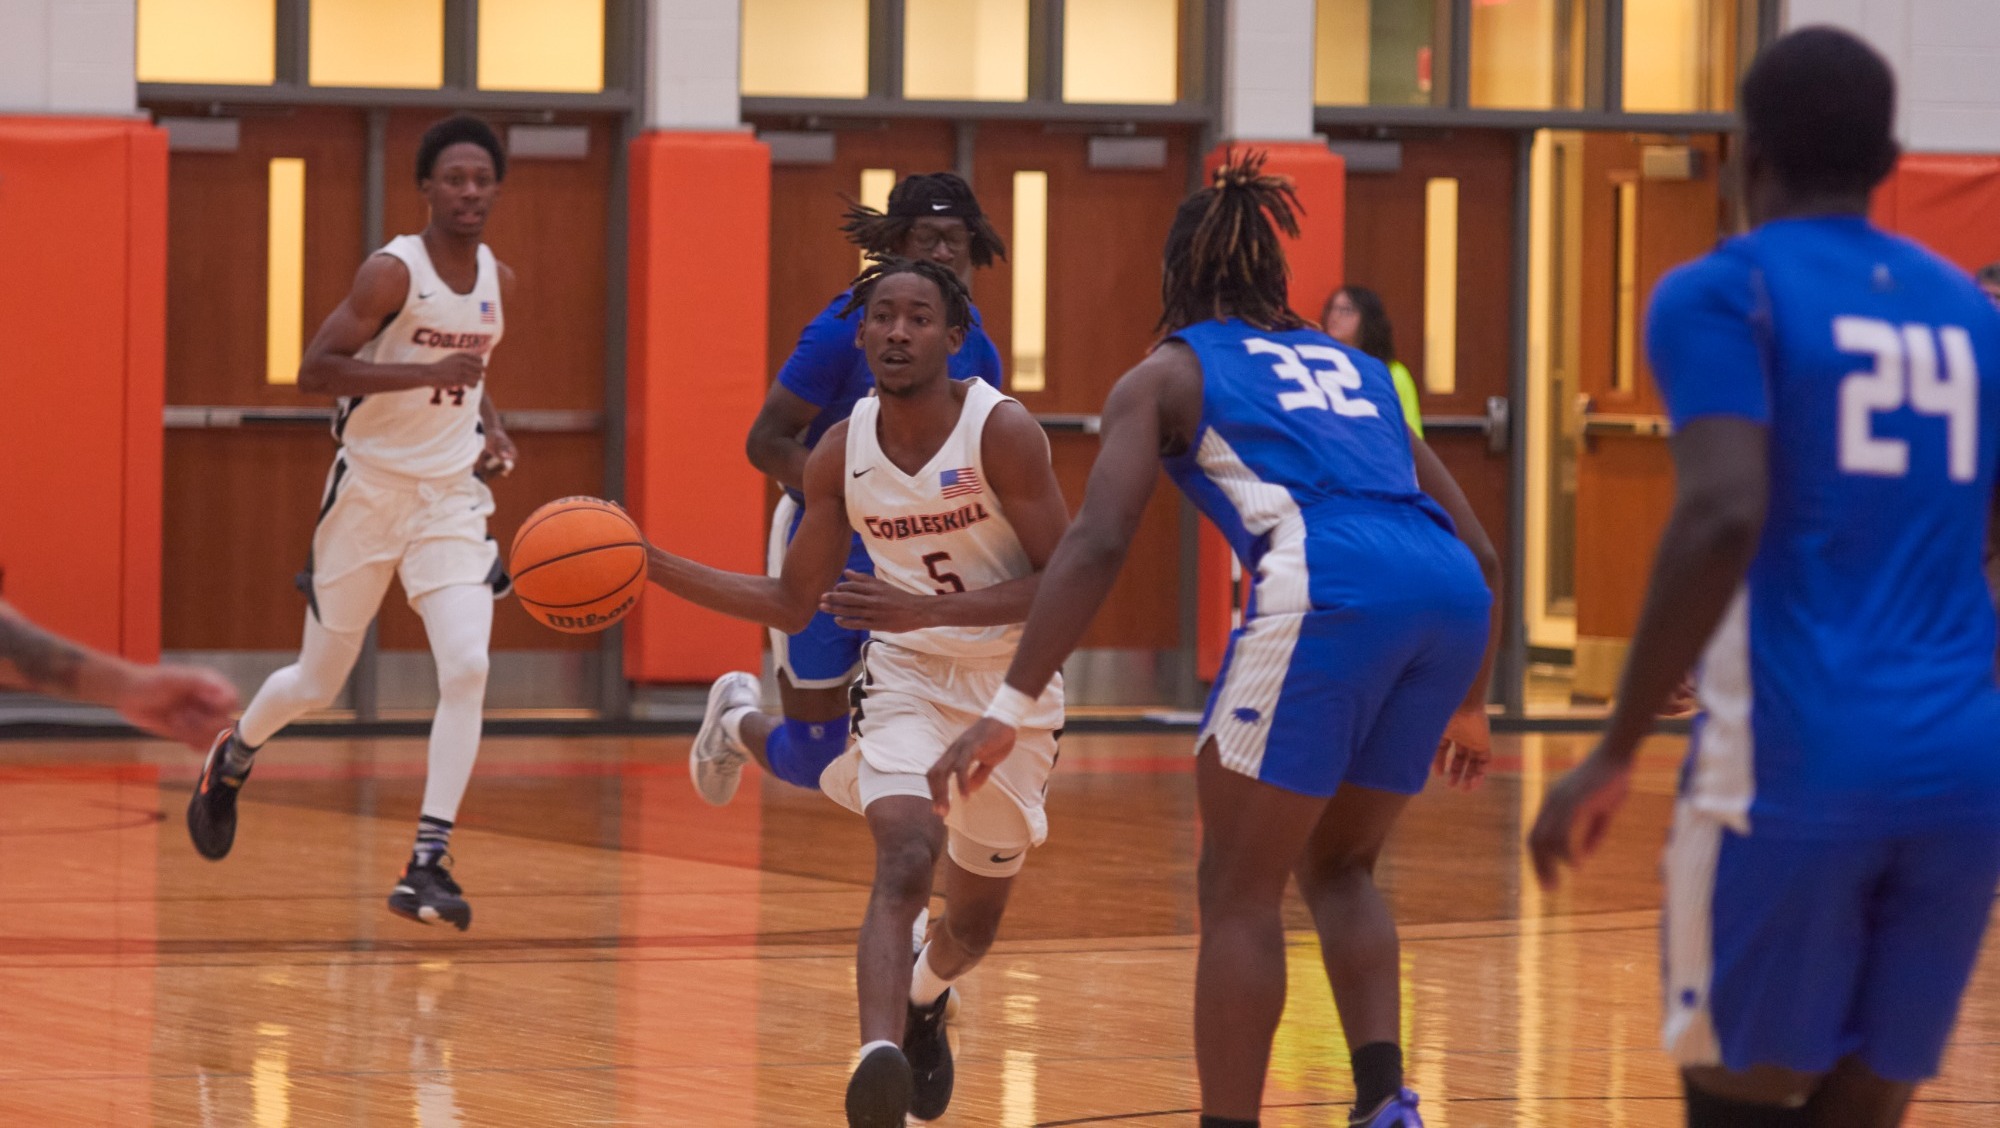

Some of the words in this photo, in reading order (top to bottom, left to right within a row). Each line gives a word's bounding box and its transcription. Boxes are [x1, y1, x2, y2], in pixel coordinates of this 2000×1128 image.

[429, 384, 465, 406] 14
[1241, 336, 1380, 418] 32
[1832, 314, 1979, 483] 24
[864, 501, 990, 541] COBLESKILL
[921, 551, 966, 596] 5
[545, 596, 635, 628] Wilson
